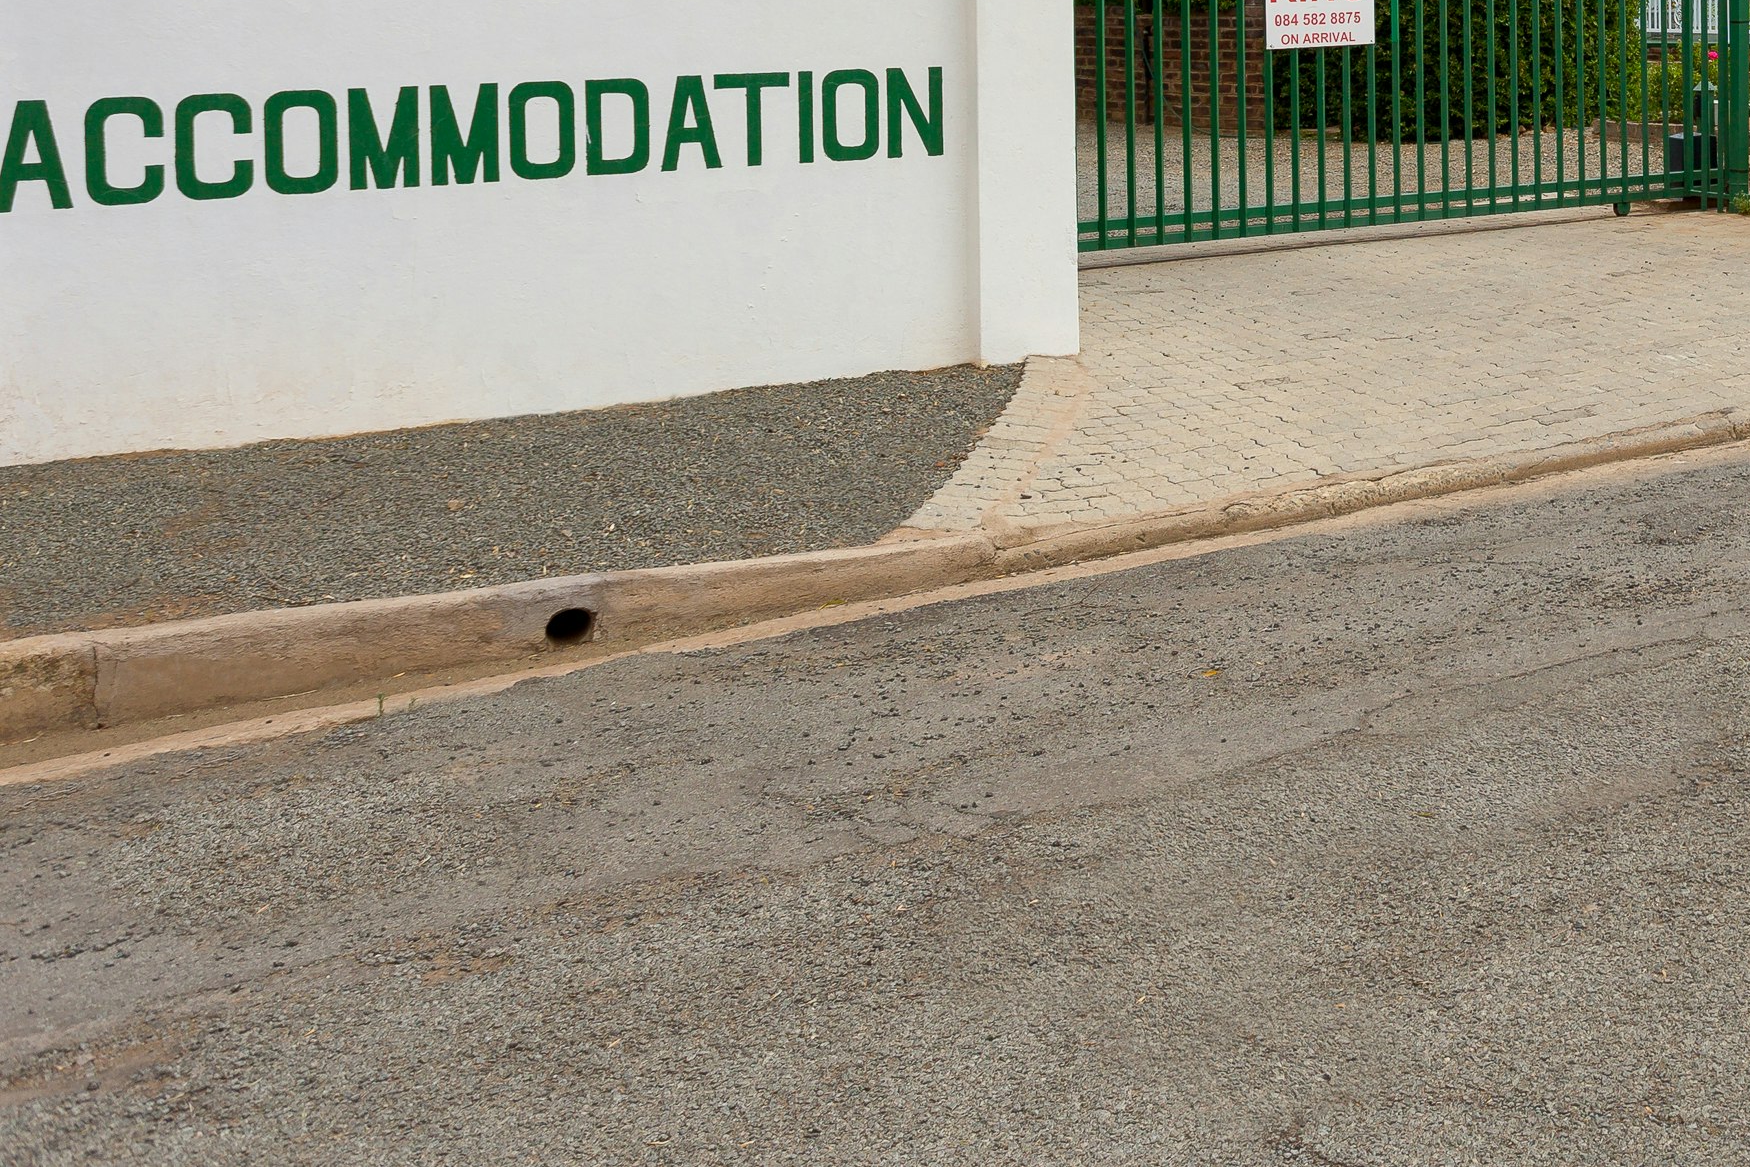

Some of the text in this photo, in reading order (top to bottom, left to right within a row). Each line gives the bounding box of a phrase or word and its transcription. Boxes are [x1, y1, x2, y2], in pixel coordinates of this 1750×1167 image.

[1274, 11, 1361, 27] 084 582 8875
[1281, 31, 1356, 45] ON ARRIVAL
[0, 67, 944, 213] ACCOMMODATION
